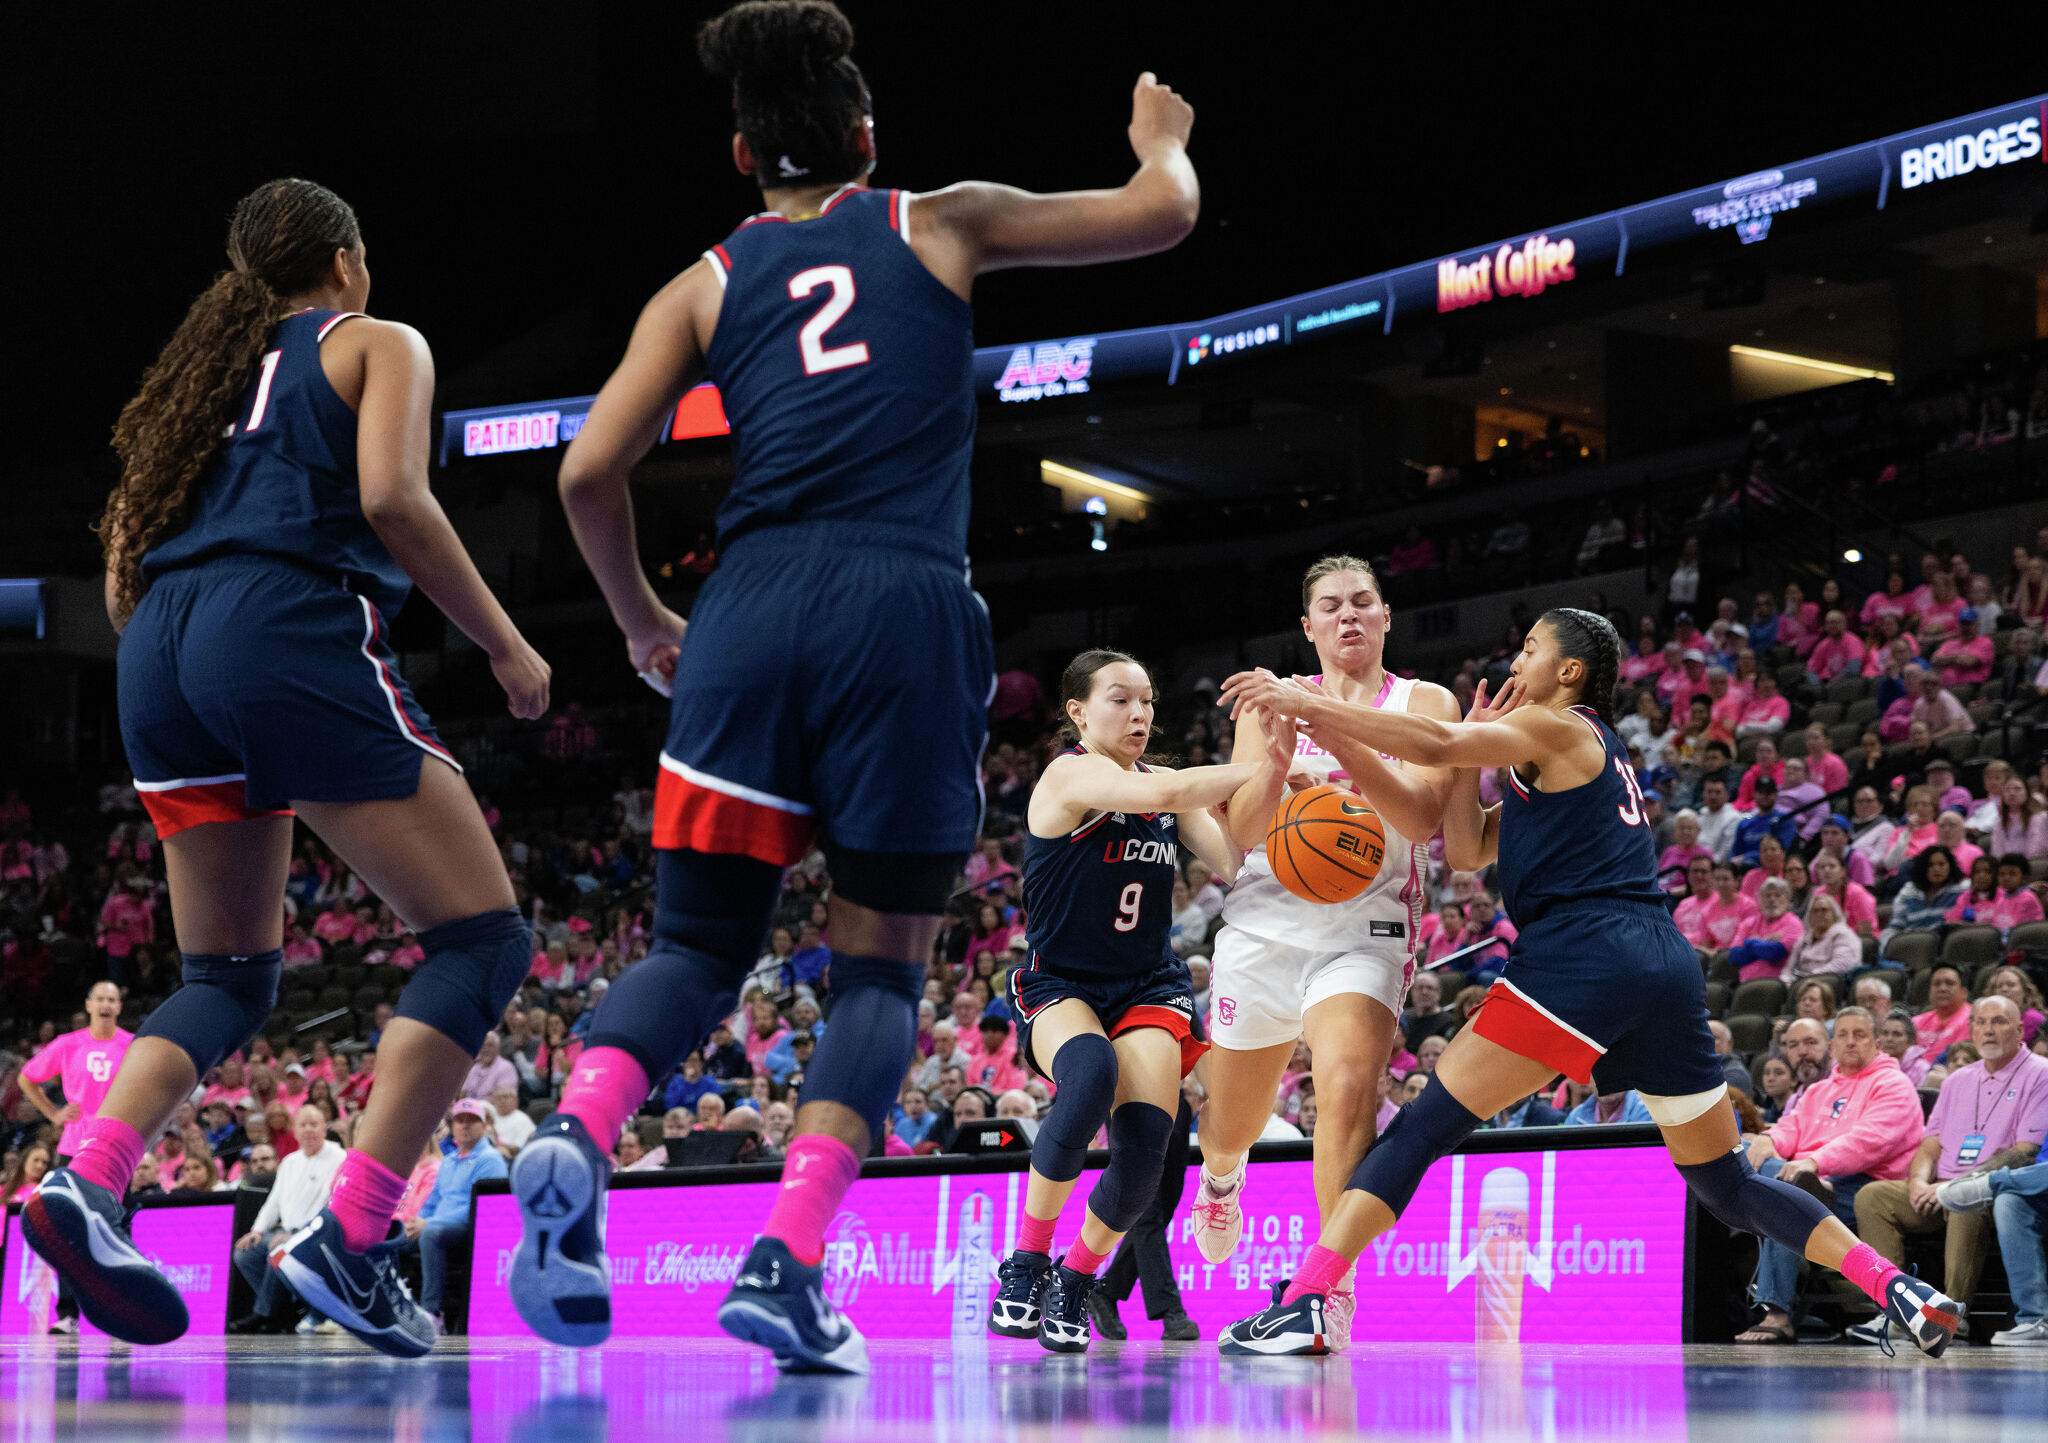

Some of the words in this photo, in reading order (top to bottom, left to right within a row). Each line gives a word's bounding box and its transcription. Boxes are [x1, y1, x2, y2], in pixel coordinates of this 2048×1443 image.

[1901, 117, 2042, 189] BRIDGES
[1494, 234, 1576, 298] Coffee
[787, 264, 871, 377] 2
[1213, 323, 1280, 356] FUSION
[994, 338, 1098, 390] ABC
[222, 349, 284, 438] 1
[464, 410, 561, 457] PATRIOT
[1103, 838, 1177, 866] UCONN
[1335, 831, 1384, 866] ELITE
[1114, 881, 1144, 933] 9
[964, 1233, 983, 1322] ULTRA
[1236, 1262, 1297, 1291] BEE
[1371, 1229, 1449, 1277] Your
[1467, 1223, 1645, 1288] Kindom
